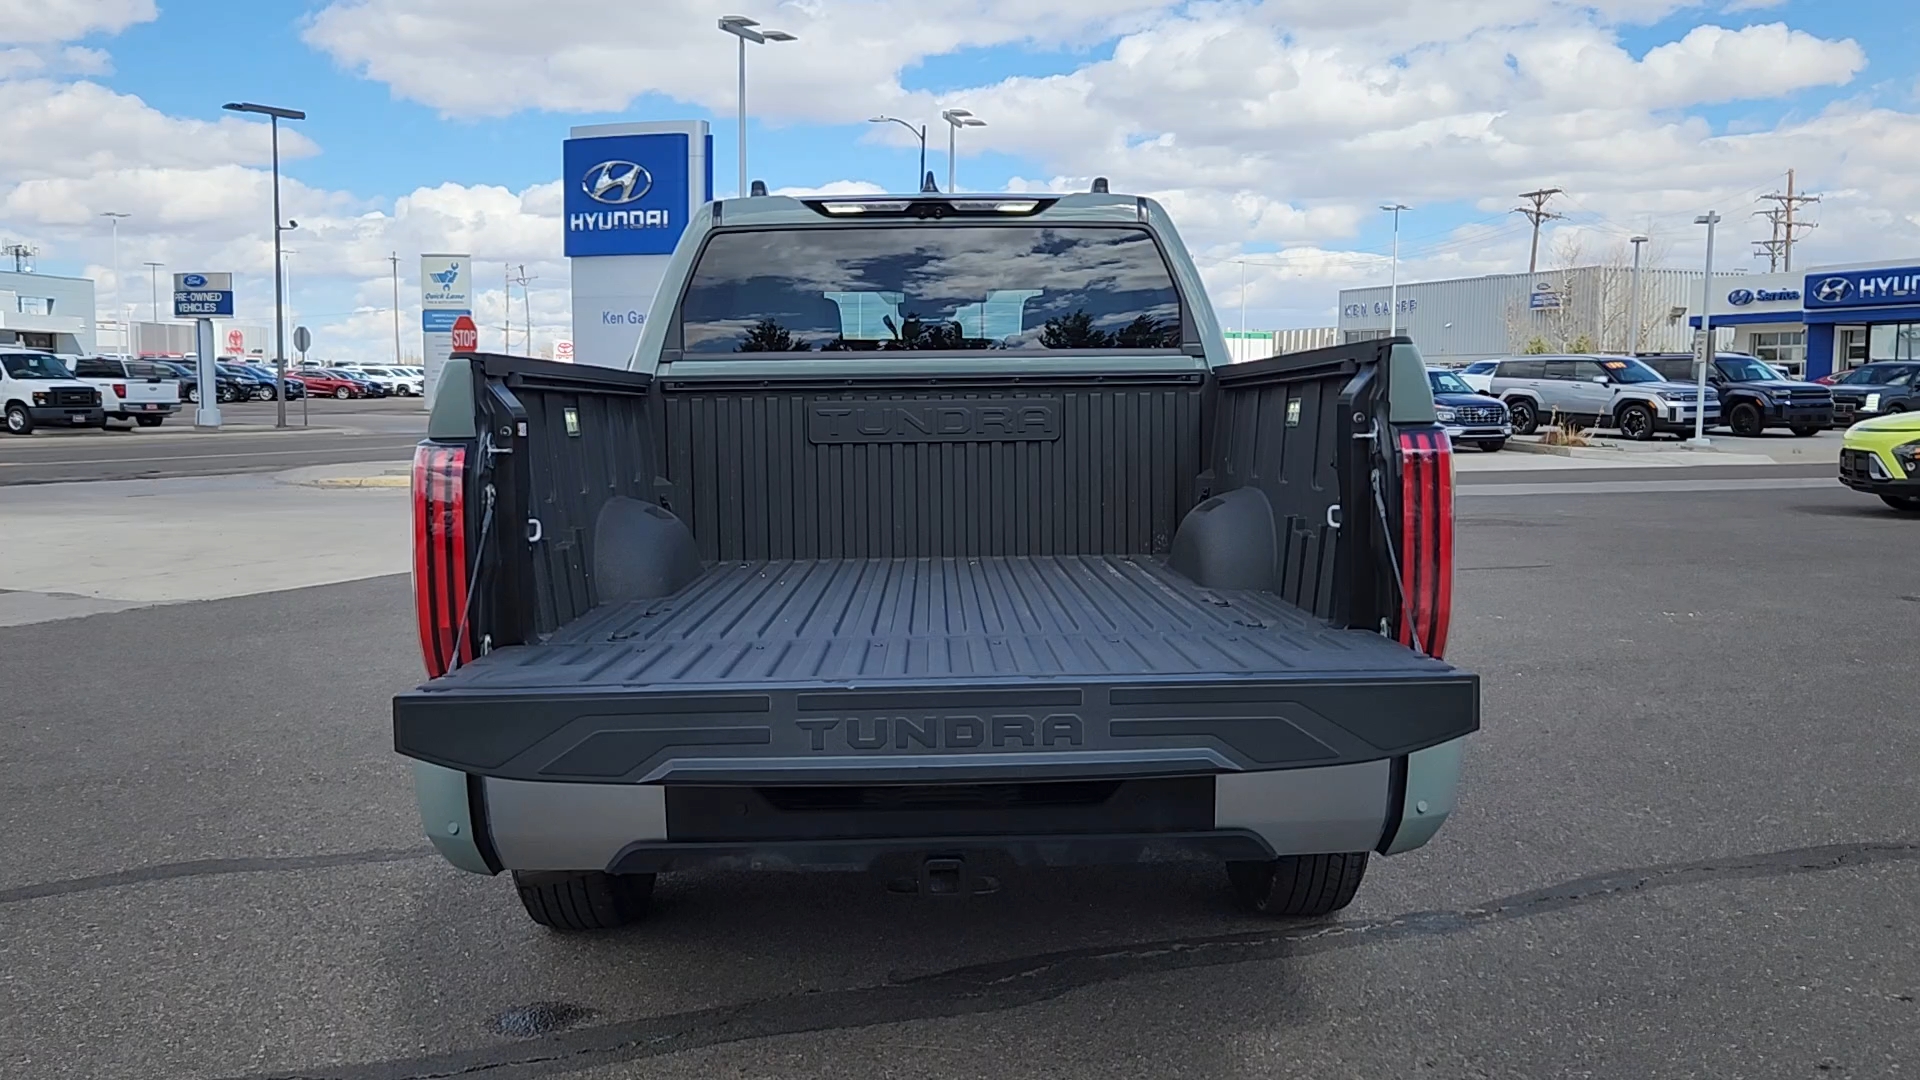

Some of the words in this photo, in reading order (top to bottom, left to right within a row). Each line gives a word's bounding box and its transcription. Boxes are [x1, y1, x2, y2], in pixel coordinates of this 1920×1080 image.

[570, 209, 669, 232] HYUNDAI
[174, 292, 222, 302] PRE-OWNED
[425, 292, 445, 300] Quick
[445, 292, 466, 300] Lane
[1756, 287, 1800, 301] Service
[178, 302, 217, 313] VEHICLES
[1344, 303, 1368, 318] KEN
[602, 311, 624, 324] Ken
[627, 310, 647, 325] Ga
[453, 329, 477, 347] STOP
[815, 405, 1053, 437] TUNDRA
[795, 713, 1083, 751] TUNDRA
